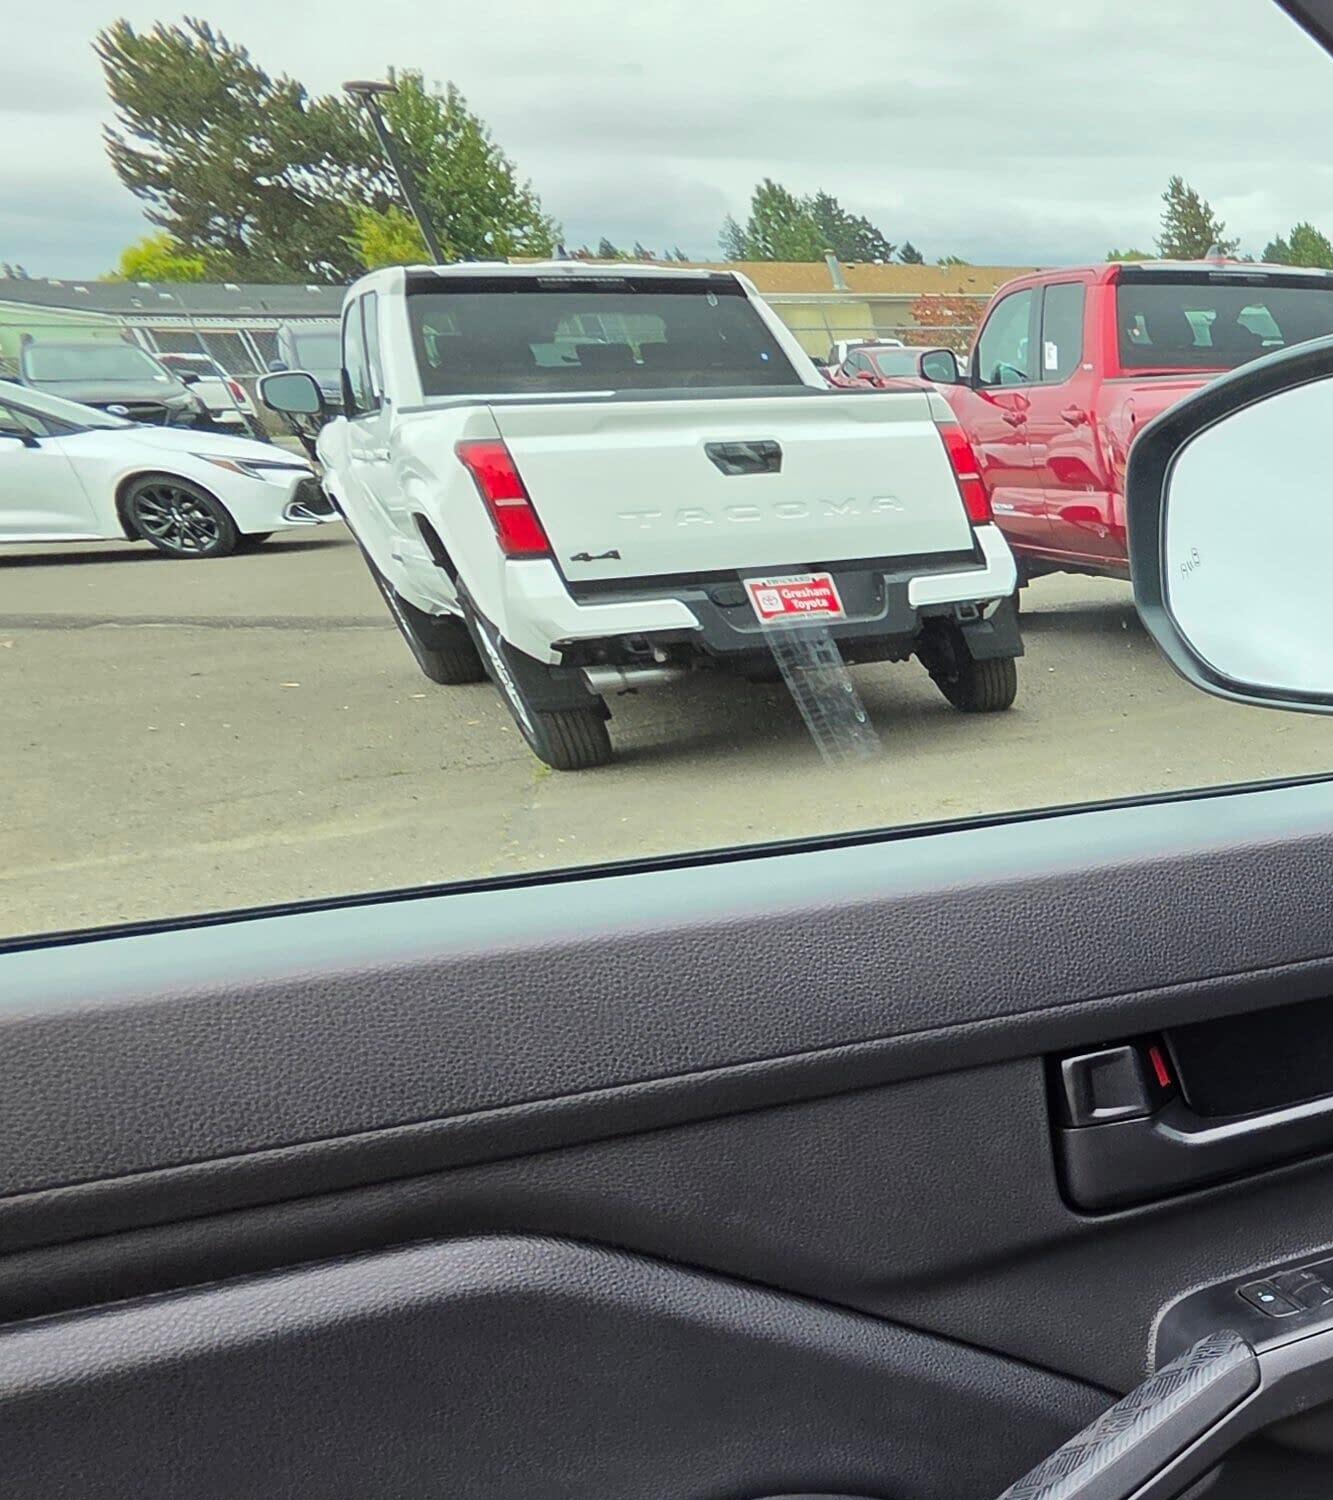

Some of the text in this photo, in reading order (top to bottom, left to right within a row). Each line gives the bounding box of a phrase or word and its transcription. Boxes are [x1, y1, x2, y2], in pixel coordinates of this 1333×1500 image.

[616, 495, 905, 529] TACOMA
[781, 587, 831, 599] Gresham
[791, 598, 829, 610] Toyota
